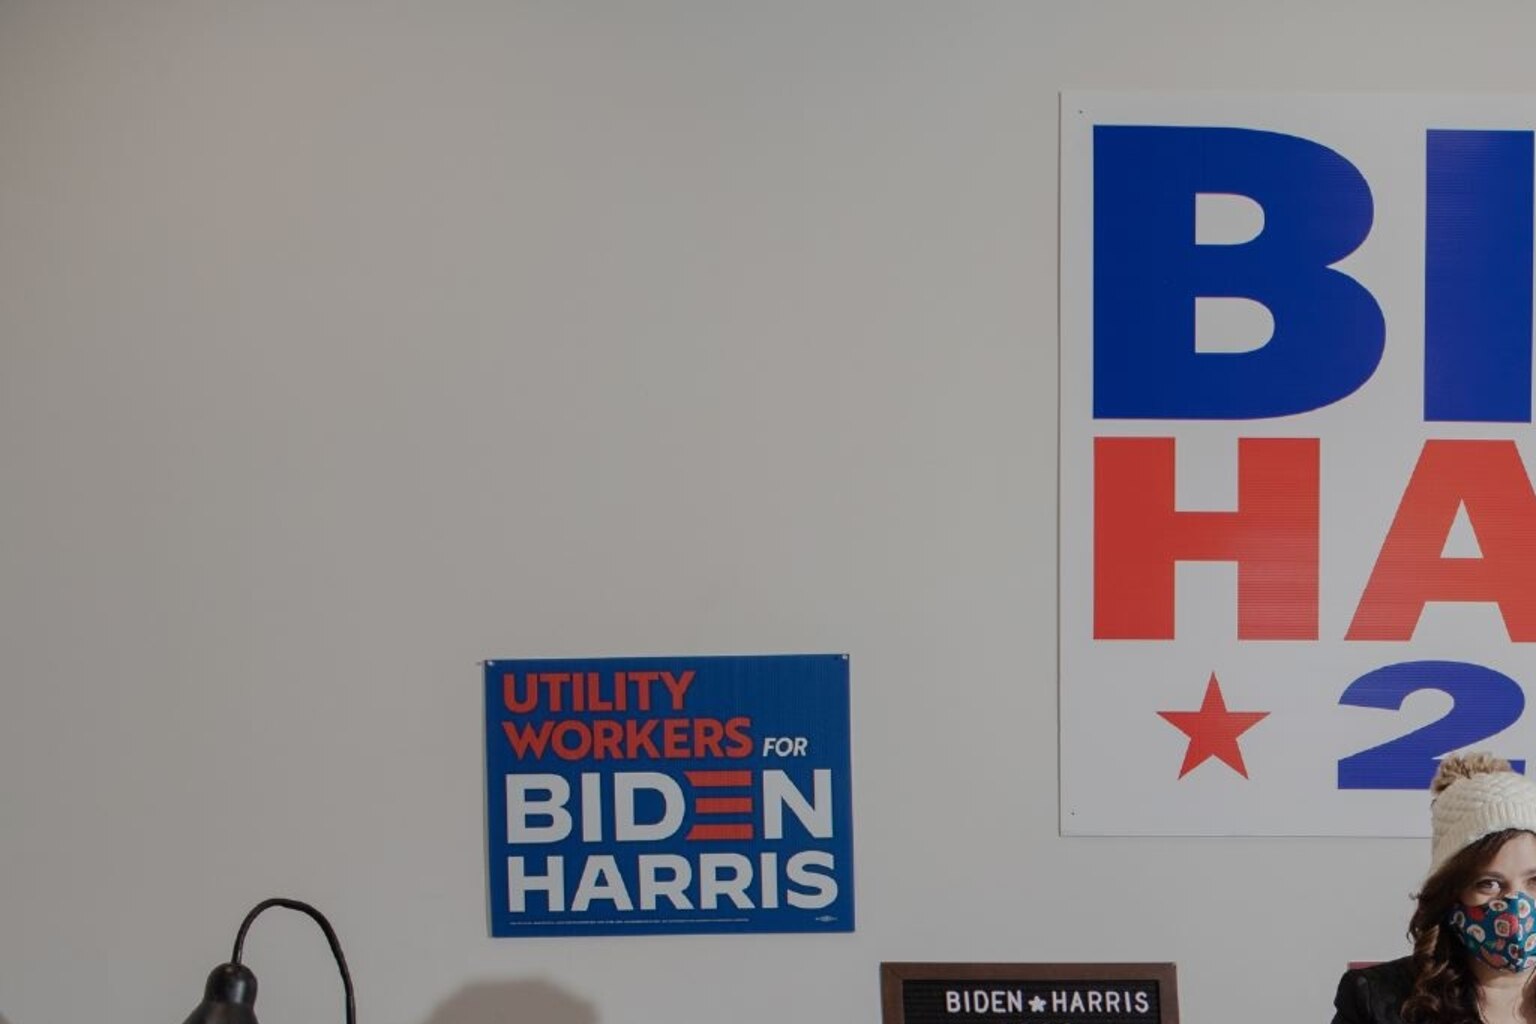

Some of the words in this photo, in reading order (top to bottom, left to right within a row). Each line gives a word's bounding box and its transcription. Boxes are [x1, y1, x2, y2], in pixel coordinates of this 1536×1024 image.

[503, 671, 696, 713] UTILITY
[502, 717, 753, 760] WORKERS
[762, 737, 808, 757] FOR
[505, 768, 834, 844] BIDEN
[507, 850, 839, 912] HARRIS
[946, 989, 1022, 1013] BIDEN
[1052, 991, 1149, 1013] HARRIS
